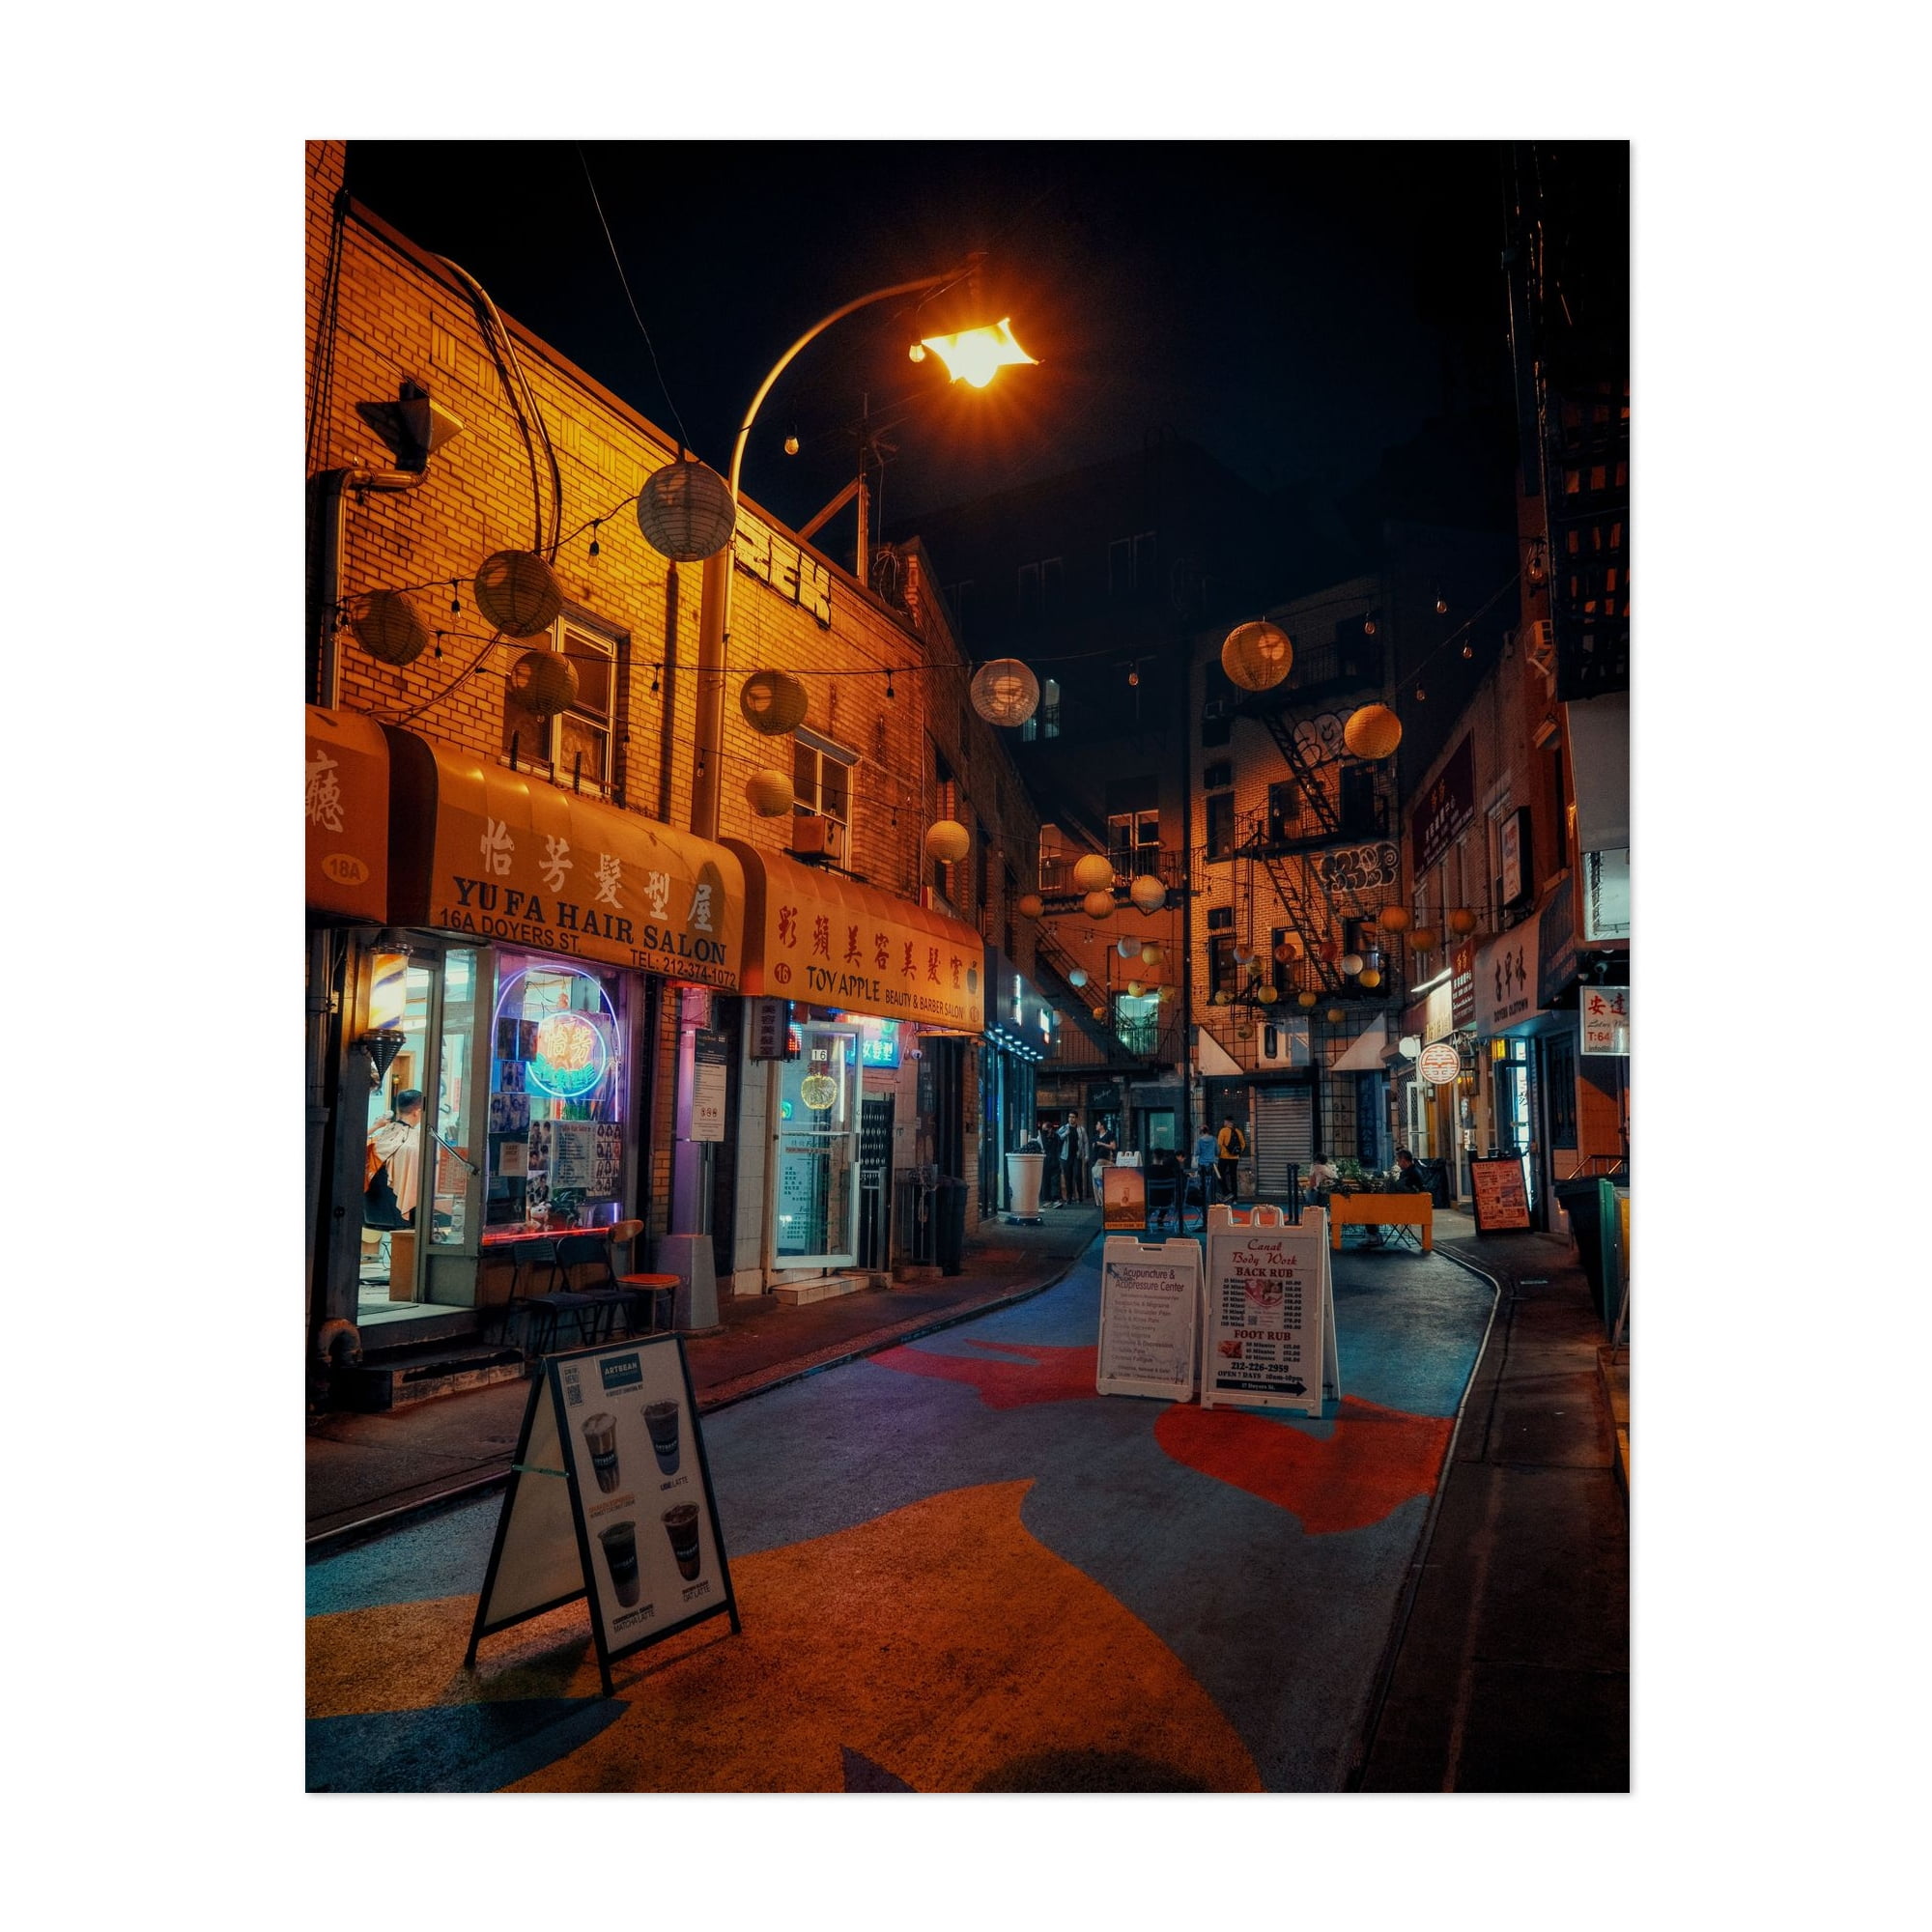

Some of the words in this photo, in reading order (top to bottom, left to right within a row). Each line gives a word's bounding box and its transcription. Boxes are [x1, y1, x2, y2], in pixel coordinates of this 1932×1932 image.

[329, 858, 362, 881] 18A
[440, 907, 476, 931] 16A
[482, 915, 554, 947] DOYERS
[559, 932, 582, 953] ST.
[556, 901, 635, 944] HAIR
[643, 924, 726, 965] SALON
[630, 949, 659, 970] TEL:
[664, 956, 735, 986] 212-374-1072
[776, 964, 790, 982] 16
[806, 965, 838, 992] TOY
[838, 973, 881, 1002] APPLE
[885, 989, 911, 1008] BEAUTY
[913, 994, 919, 1009] &
[920, 996, 944, 1014] BARBER
[945, 1003, 963, 1019] SALON
[1588, 992, 1627, 1015] 安達
[813, 1050, 827, 1061] 16
[1247, 1238, 1282, 1251] Canal
[1233, 1252, 1260, 1266] Body
[1266, 1252, 1297, 1264] Work
[1123, 1267, 1168, 1279] Acupuncture
[1169, 1269, 1176, 1280] &
[1236, 1266, 1266, 1276] BACK
[1269, 1268, 1293, 1278] RUB
[1115, 1279, 1158, 1291] Acupressure
[1160, 1281, 1184, 1293] Center
[1234, 1329, 1264, 1339] FOOT
[1267, 1331, 1291, 1341] RUB
[605, 1362, 638, 1376] ARTBEAN
[1231, 1362, 1290, 1372] 212-226-2959
[671, 1476, 689, 1488] LATTE
[694, 1585, 711, 1599] LATTE
[638, 1609, 655, 1624] LATTE
